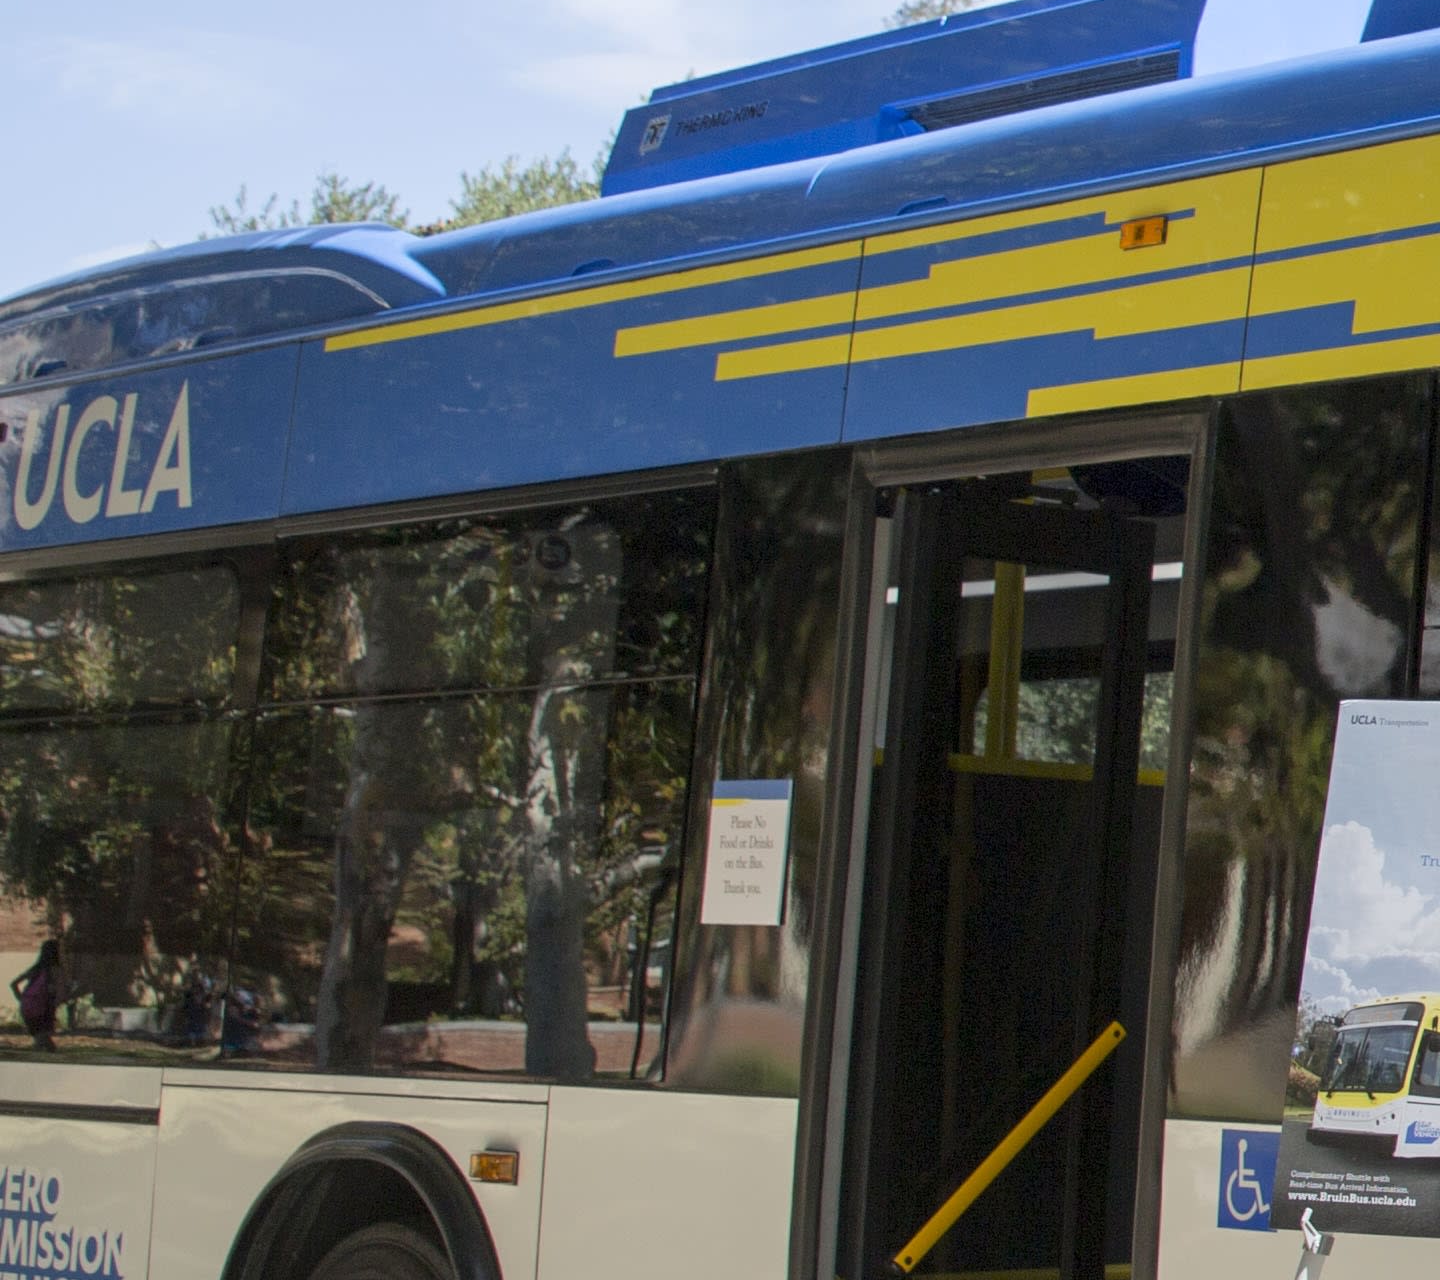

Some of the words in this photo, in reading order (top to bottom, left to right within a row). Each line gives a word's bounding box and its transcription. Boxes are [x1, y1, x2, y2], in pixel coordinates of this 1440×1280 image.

[14, 378, 192, 530] UCLA
[1350, 715, 1378, 726] UCLA
[754, 815, 767, 830] No
[720, 834, 738, 850] Food
[1290, 1169, 1345, 1182] Complimentary
[1289, 1179, 1323, 1189] Real-time
[1324, 1181, 1338, 1190] Bus
[1340, 1182, 1365, 1192] Arrival
[1287, 1190, 1417, 1207] www.BruinBus.ucla.edu
[0, 1216, 127, 1277] MISSION
